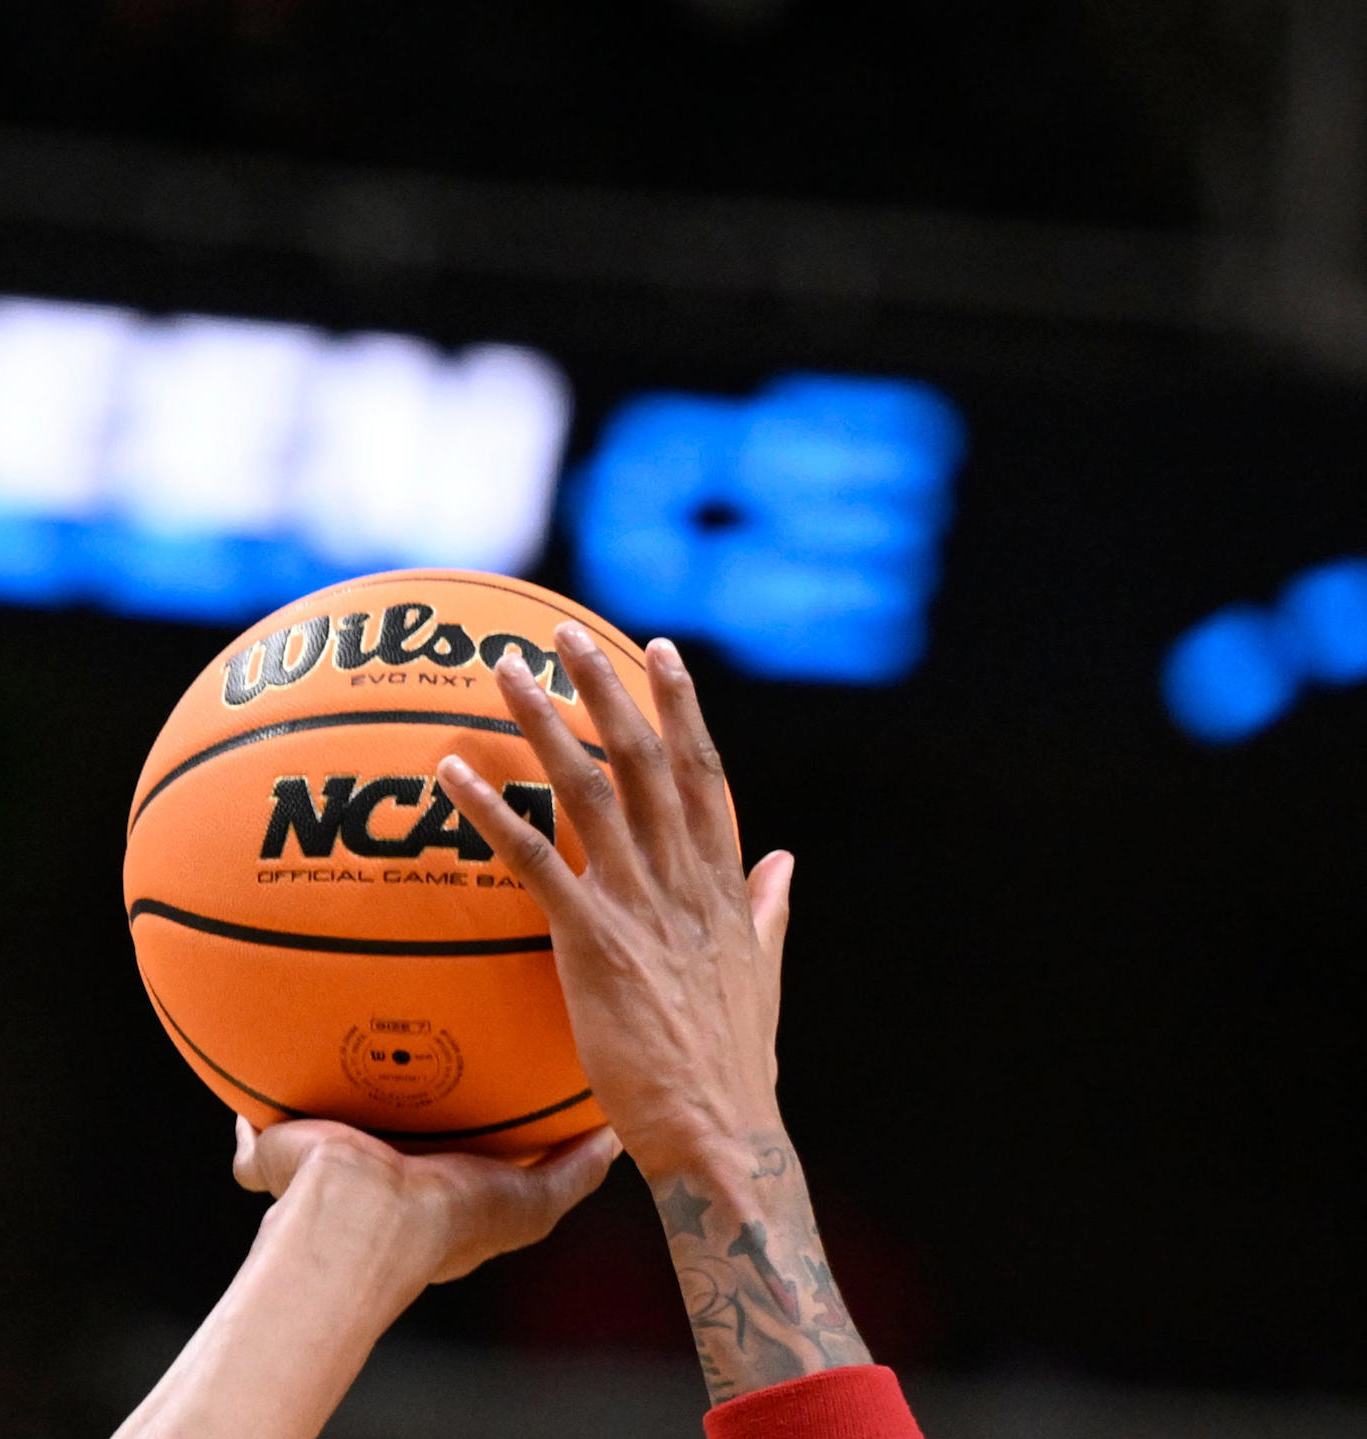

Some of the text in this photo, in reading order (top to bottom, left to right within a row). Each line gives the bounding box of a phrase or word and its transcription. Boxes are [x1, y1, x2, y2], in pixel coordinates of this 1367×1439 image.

[350, 672, 477, 689] EVO NXT
[256, 869, 526, 890] OFFICIAL GAME BA
